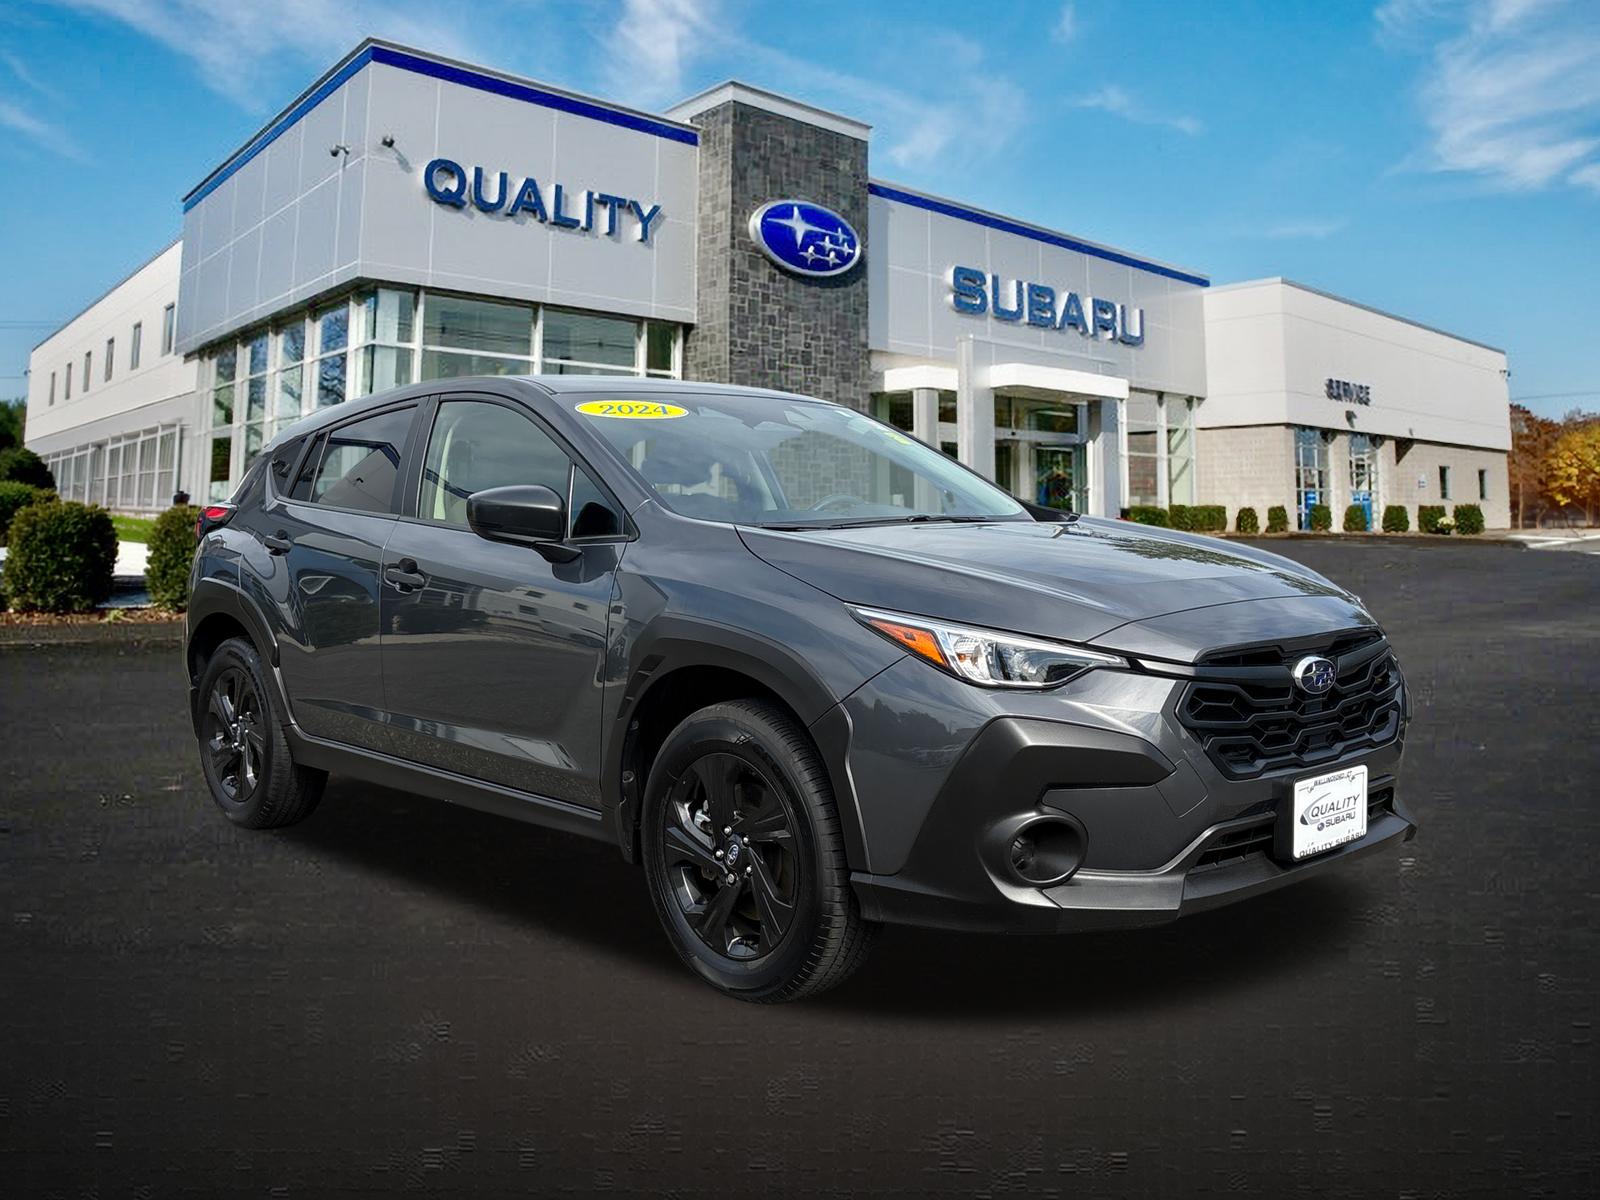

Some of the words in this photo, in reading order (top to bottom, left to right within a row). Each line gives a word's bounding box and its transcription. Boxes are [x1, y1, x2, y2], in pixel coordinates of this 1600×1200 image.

[423, 158, 661, 242] QUALITY
[950, 265, 1145, 346] SUBARU
[1325, 378, 1370, 406] SERVICE
[599, 404, 669, 415] 2024
[1311, 794, 1360, 817] QUALITY
[1325, 811, 1356, 827] SUBARU
[1300, 841, 1333, 857] QUALITY
